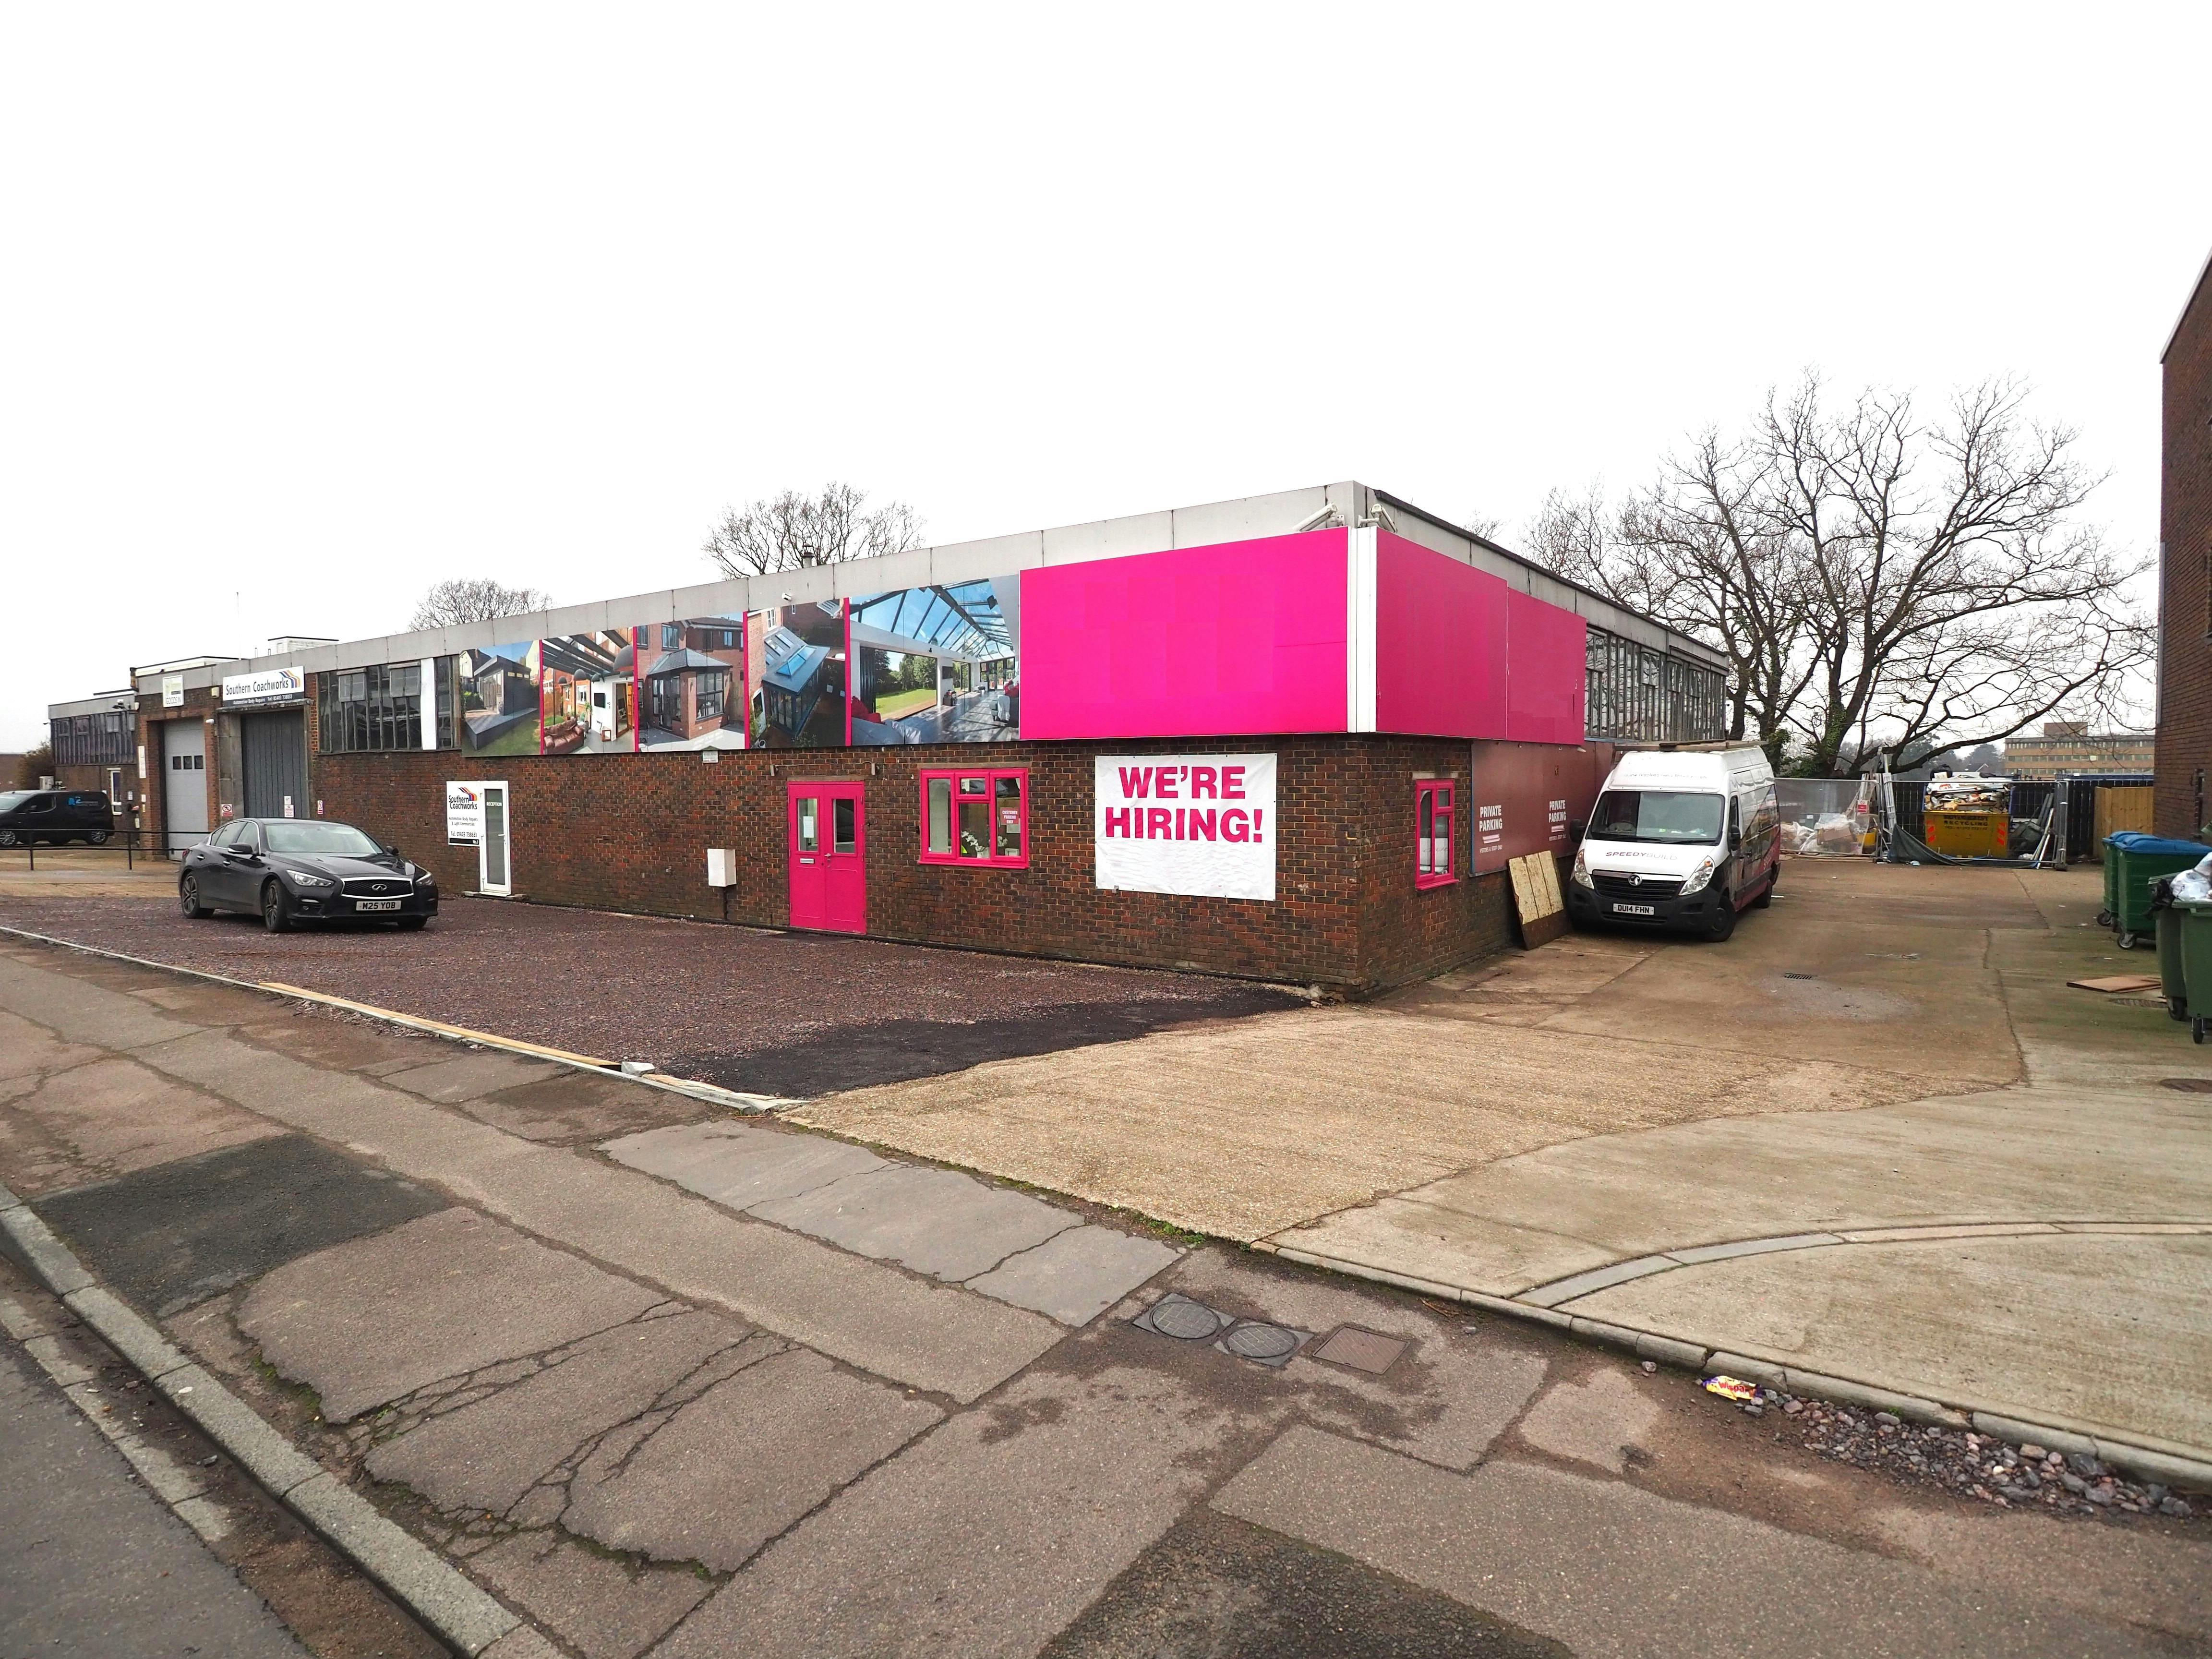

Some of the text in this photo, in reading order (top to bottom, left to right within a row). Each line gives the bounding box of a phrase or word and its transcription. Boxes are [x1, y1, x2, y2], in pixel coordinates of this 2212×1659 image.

[226, 677, 289, 695] Southern Coachworks
[449, 795, 469, 803] Southern
[450, 801, 478, 810] Coachworks
[1480, 805, 1502, 818] PRIVATE
[1549, 800, 1565, 811] PRIVATE
[1549, 811, 1566, 823] PARKING
[1106, 807, 1262, 843] HIRING!
[1479, 818, 1503, 832] PARKING
[1606, 852, 1677, 860] SPEEDYBUILD
[1718, 1379, 1746, 1393] Wispa
